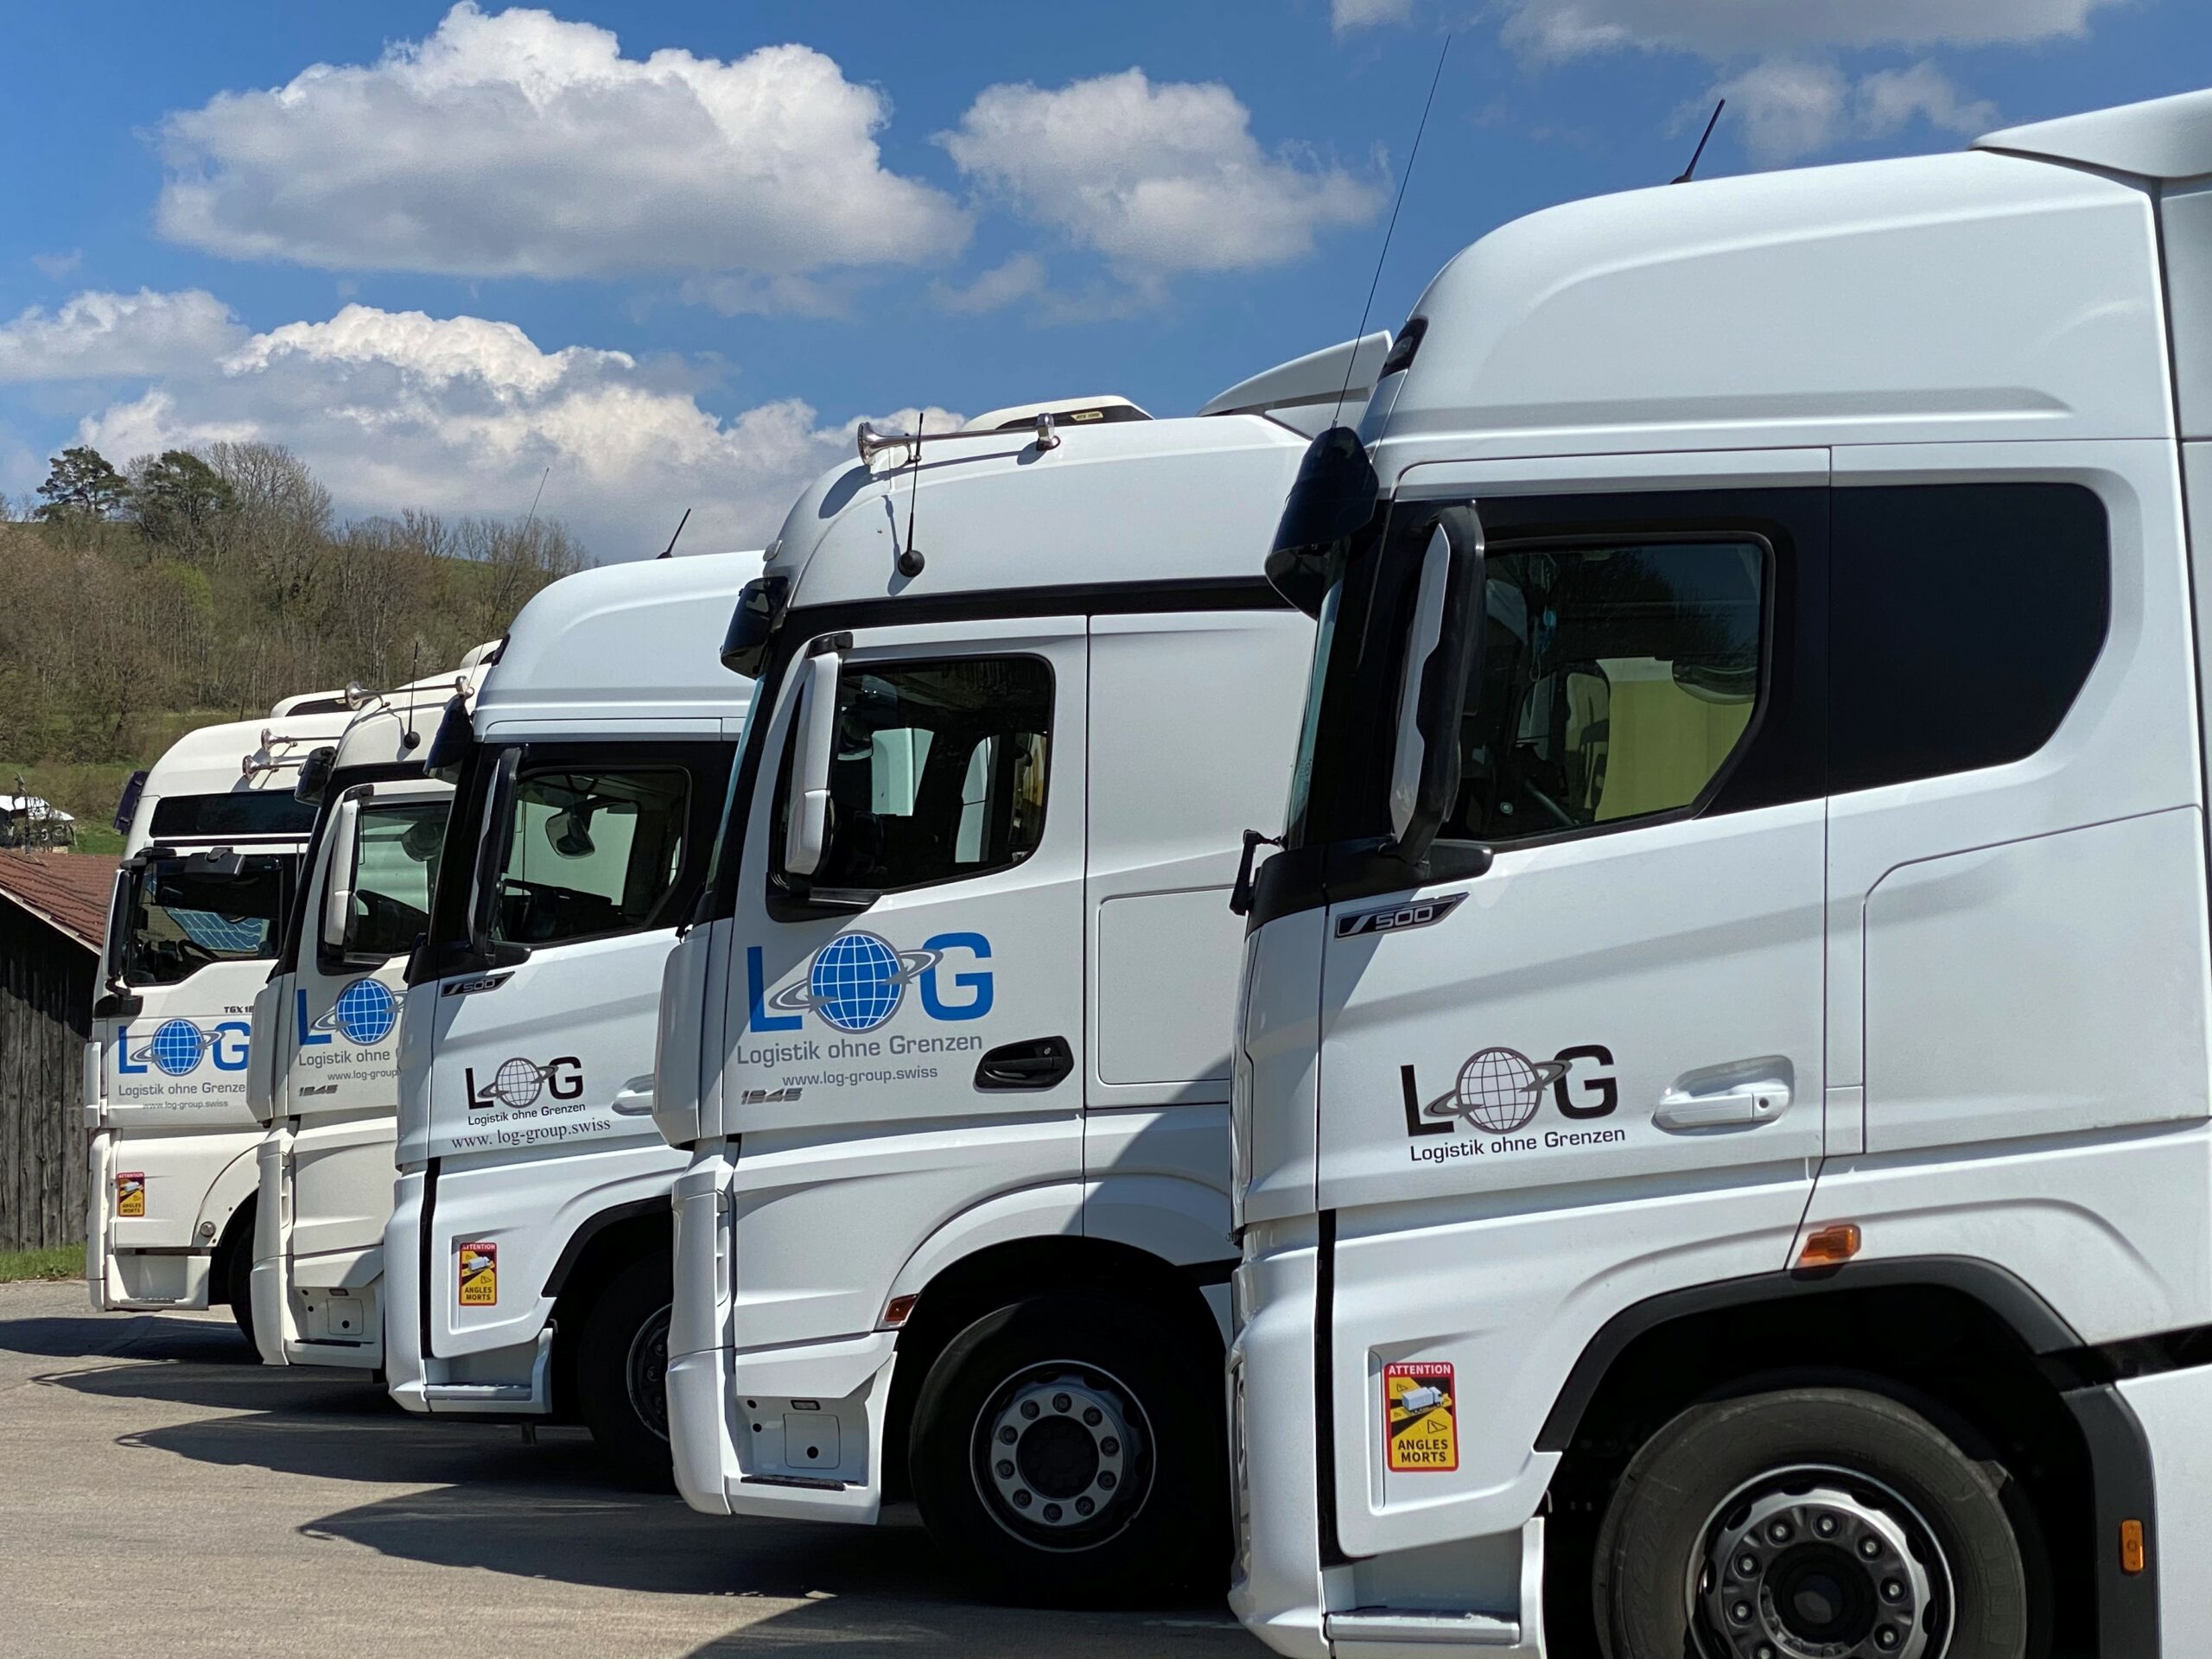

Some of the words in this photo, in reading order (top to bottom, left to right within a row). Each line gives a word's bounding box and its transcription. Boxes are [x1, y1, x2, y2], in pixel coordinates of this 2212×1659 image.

[1376, 906, 1433, 931] 500
[463, 980, 496, 993] 500
[747, 930, 993, 1033] LOG
[297, 977, 399, 1046] LO
[299, 1051, 352, 1068] Logistik
[356, 1049, 391, 1063] ohne
[737, 1041, 820, 1068] Logistik
[828, 1039, 881, 1058] ohne
[889, 1035, 983, 1055] Grenzen
[327, 1070, 398, 1080] www.log-group
[465, 1056, 584, 1109] LOG
[783, 1065, 938, 1087] www.log-group.swiss
[118, 1083, 164, 1098] Logistik
[168, 1084, 197, 1095] ohne
[201, 1082, 246, 1094] Grenze
[1400, 1045, 1618, 1137] LOG
[468, 1112, 509, 1126] Logistik
[512, 1109, 537, 1120] ohne
[541, 1103, 586, 1116] Grenzen
[452, 1136, 493, 1148] www.
[497, 1117, 611, 1145] log-group.swiss
[1410, 1139, 1484, 1163] Logistik
[1491, 1136, 1537, 1154] ohne
[1544, 1128, 1625, 1148] Grenzen
[1389, 1365, 1452, 1375] ATTENTION
[1397, 1440, 1448, 1450] ANGLES
[1401, 1452, 1446, 1462] MORTS
